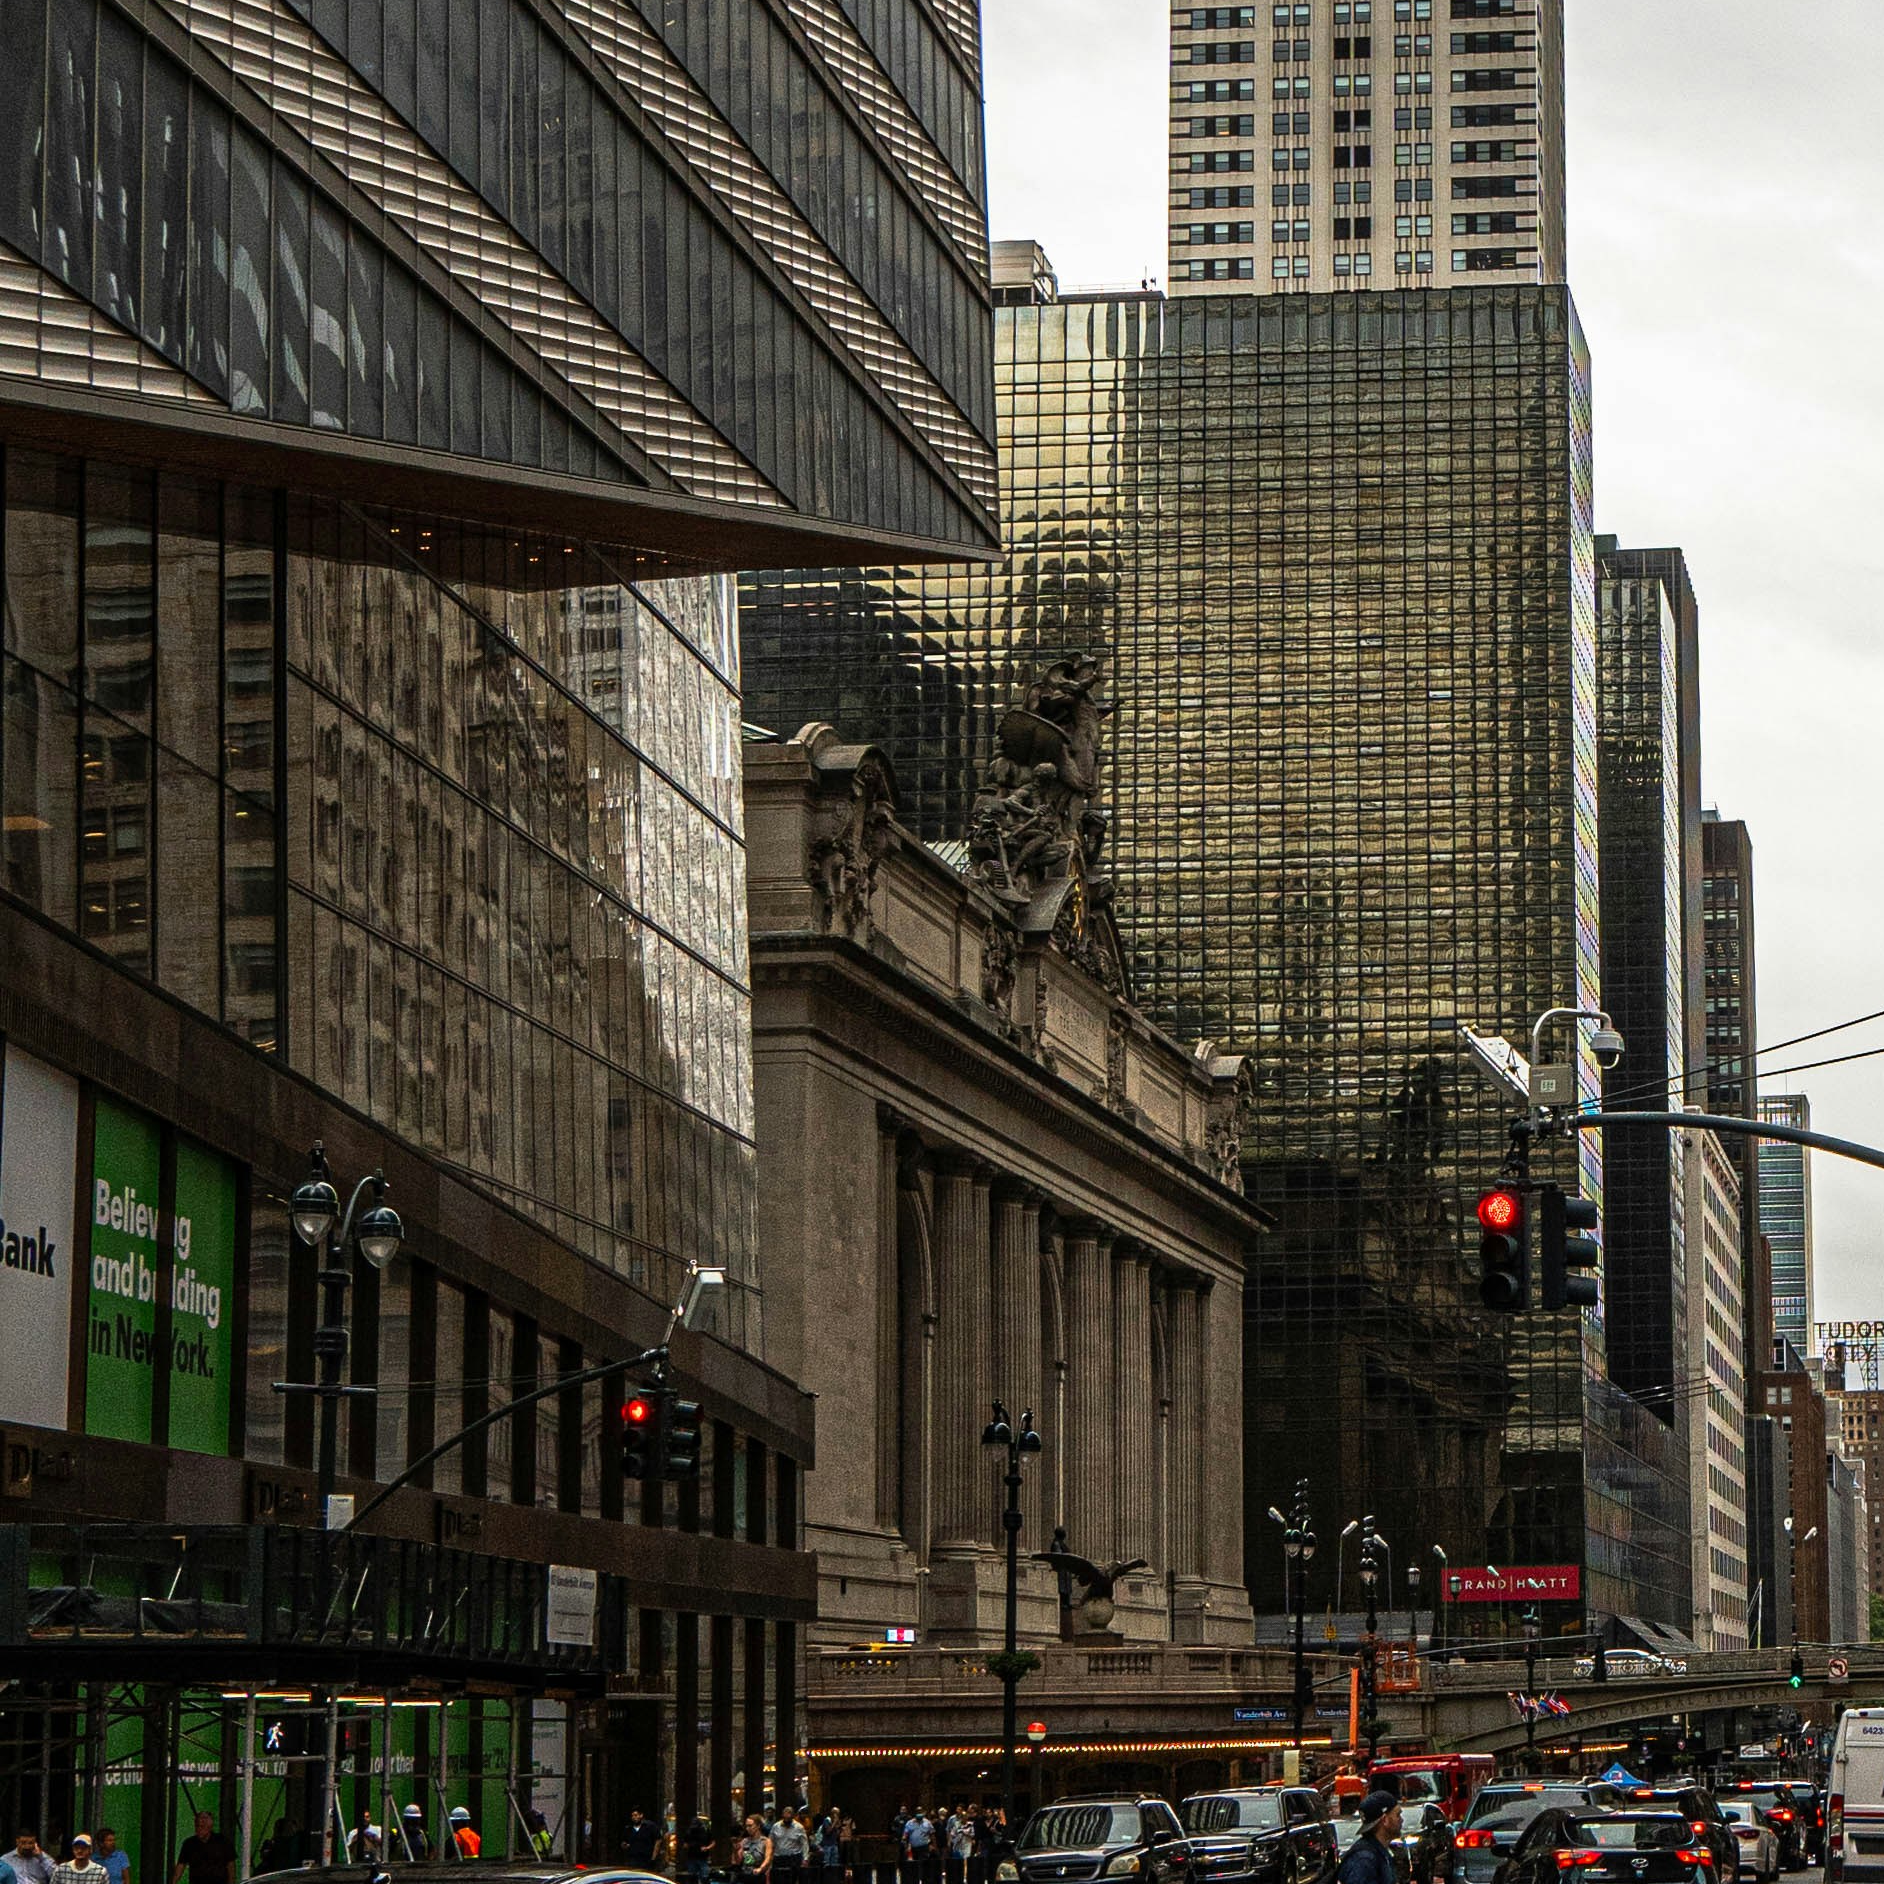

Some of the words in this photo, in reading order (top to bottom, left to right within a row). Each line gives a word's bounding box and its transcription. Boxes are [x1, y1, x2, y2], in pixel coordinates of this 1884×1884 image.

[94, 1178, 192, 1260] Believg
[93, 1252, 135, 1297] and
[137, 1254, 221, 1329] blding
[91, 1307, 110, 1356] in
[1456, 1579, 1506, 1590] RAND
[1516, 1577, 1567, 1590] HATT
[1236, 1709, 1273, 1718] Vanderbilt
